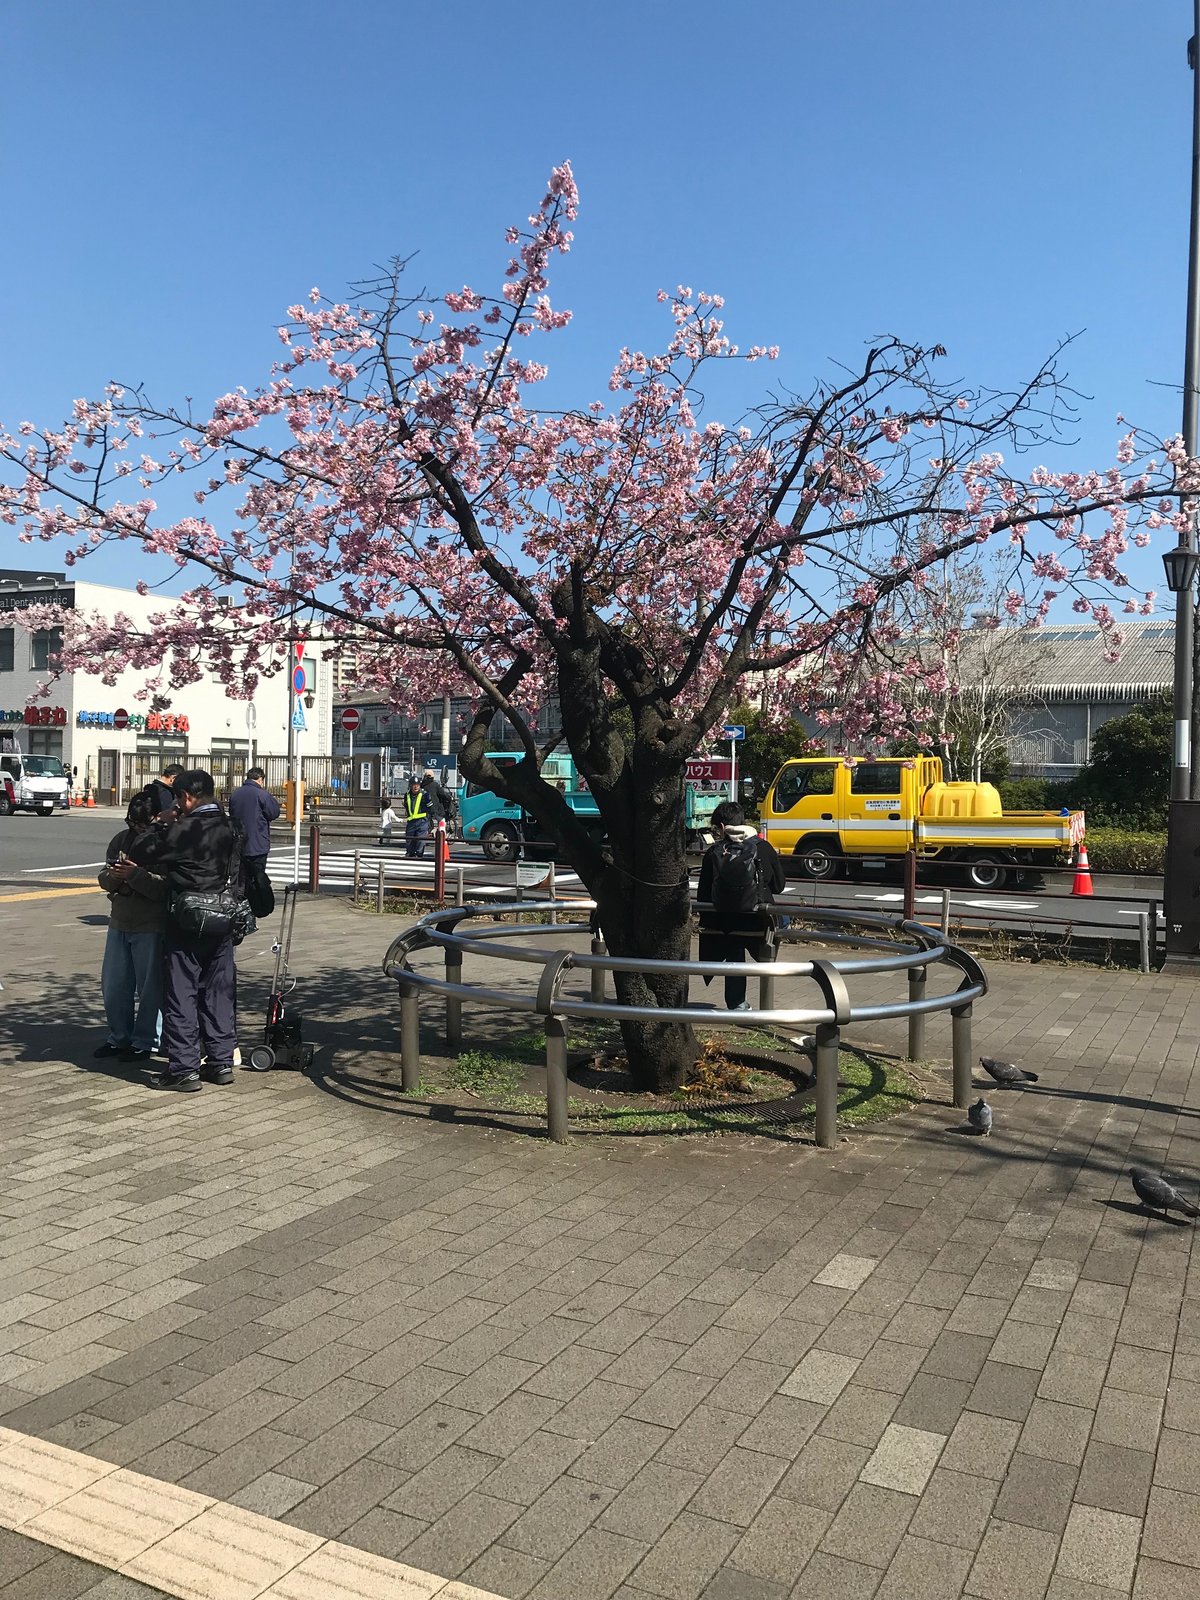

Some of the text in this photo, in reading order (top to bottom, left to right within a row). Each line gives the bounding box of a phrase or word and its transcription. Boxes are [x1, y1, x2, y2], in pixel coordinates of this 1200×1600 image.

[11, 597, 37, 607] Dental
[39, 595, 68, 605] Clinic
[147, 713, 190, 732] 銚子丸
[685, 765, 713, 777] ハウス
